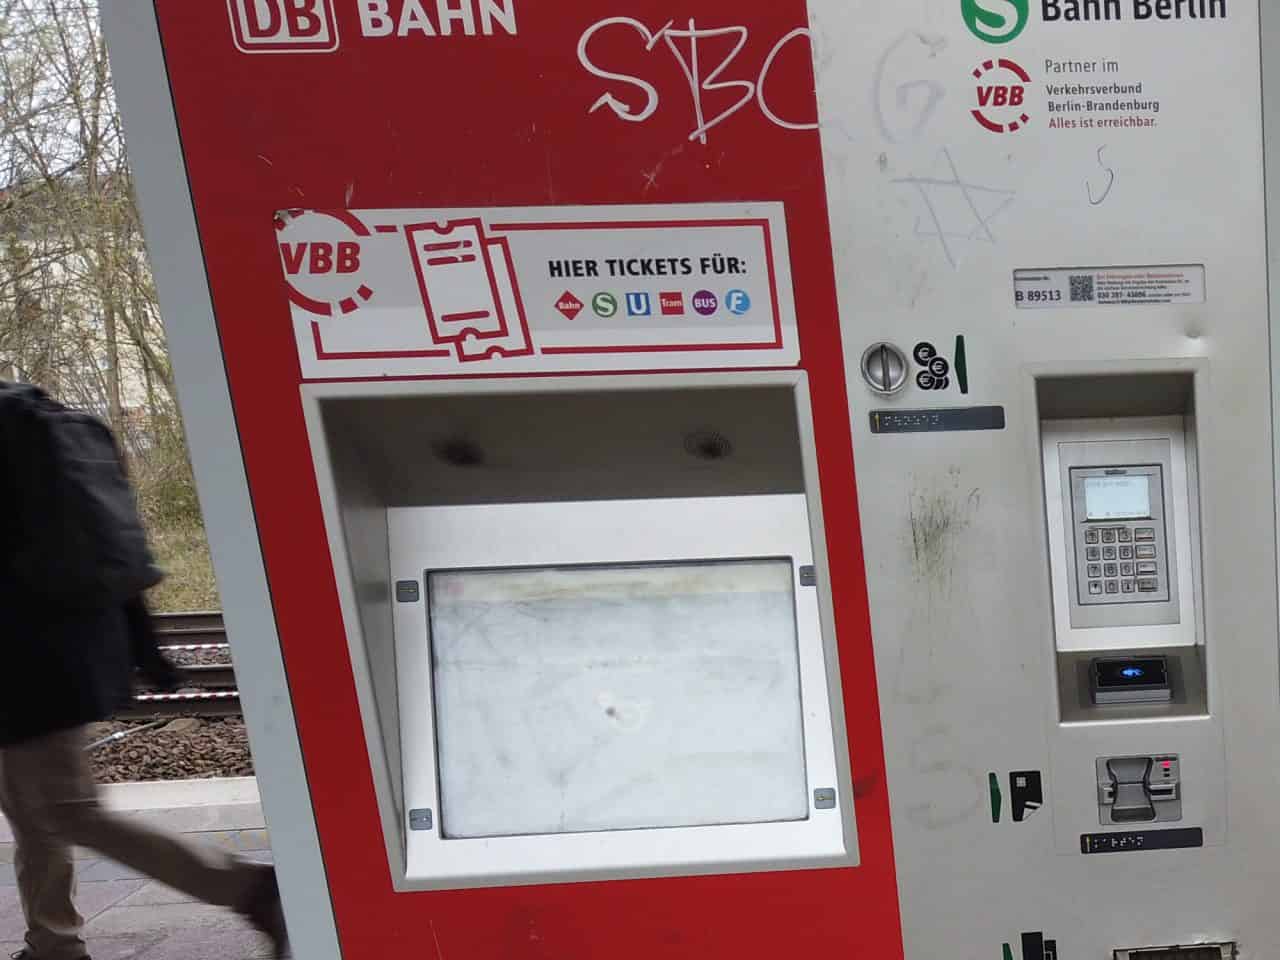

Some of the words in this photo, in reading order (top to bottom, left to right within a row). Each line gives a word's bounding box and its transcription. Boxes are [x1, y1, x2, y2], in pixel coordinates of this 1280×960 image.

[244, 0, 322, 38] DB
[357, 0, 518, 37] BAHN
[1041, 0, 1121, 22] Bahn
[1133, 0, 1227, 20] Berlin
[1045, 59, 1097, 74] Partner
[1102, 58, 1119, 73] im
[976, 84, 1025, 107] VBB
[1046, 82, 1143, 96] Verkehrsverbund
[1047, 100, 1160, 113] Berlin-Brandenburg
[1049, 117, 1078, 129] Alles
[1080, 116, 1094, 128] ist
[1097, 116, 1158, 128] erreichbar.
[279, 241, 361, 275] VBB
[548, 260, 599, 277] HIER
[605, 258, 692, 276] TICKETS
[700, 253, 747, 275] FÜR:
[595, 294, 614, 316] S
[629, 293, 647, 315] U
[694, 297, 716, 309] BUS
[1015, 290, 1024, 301] B
[1028, 289, 1062, 301] 89513
